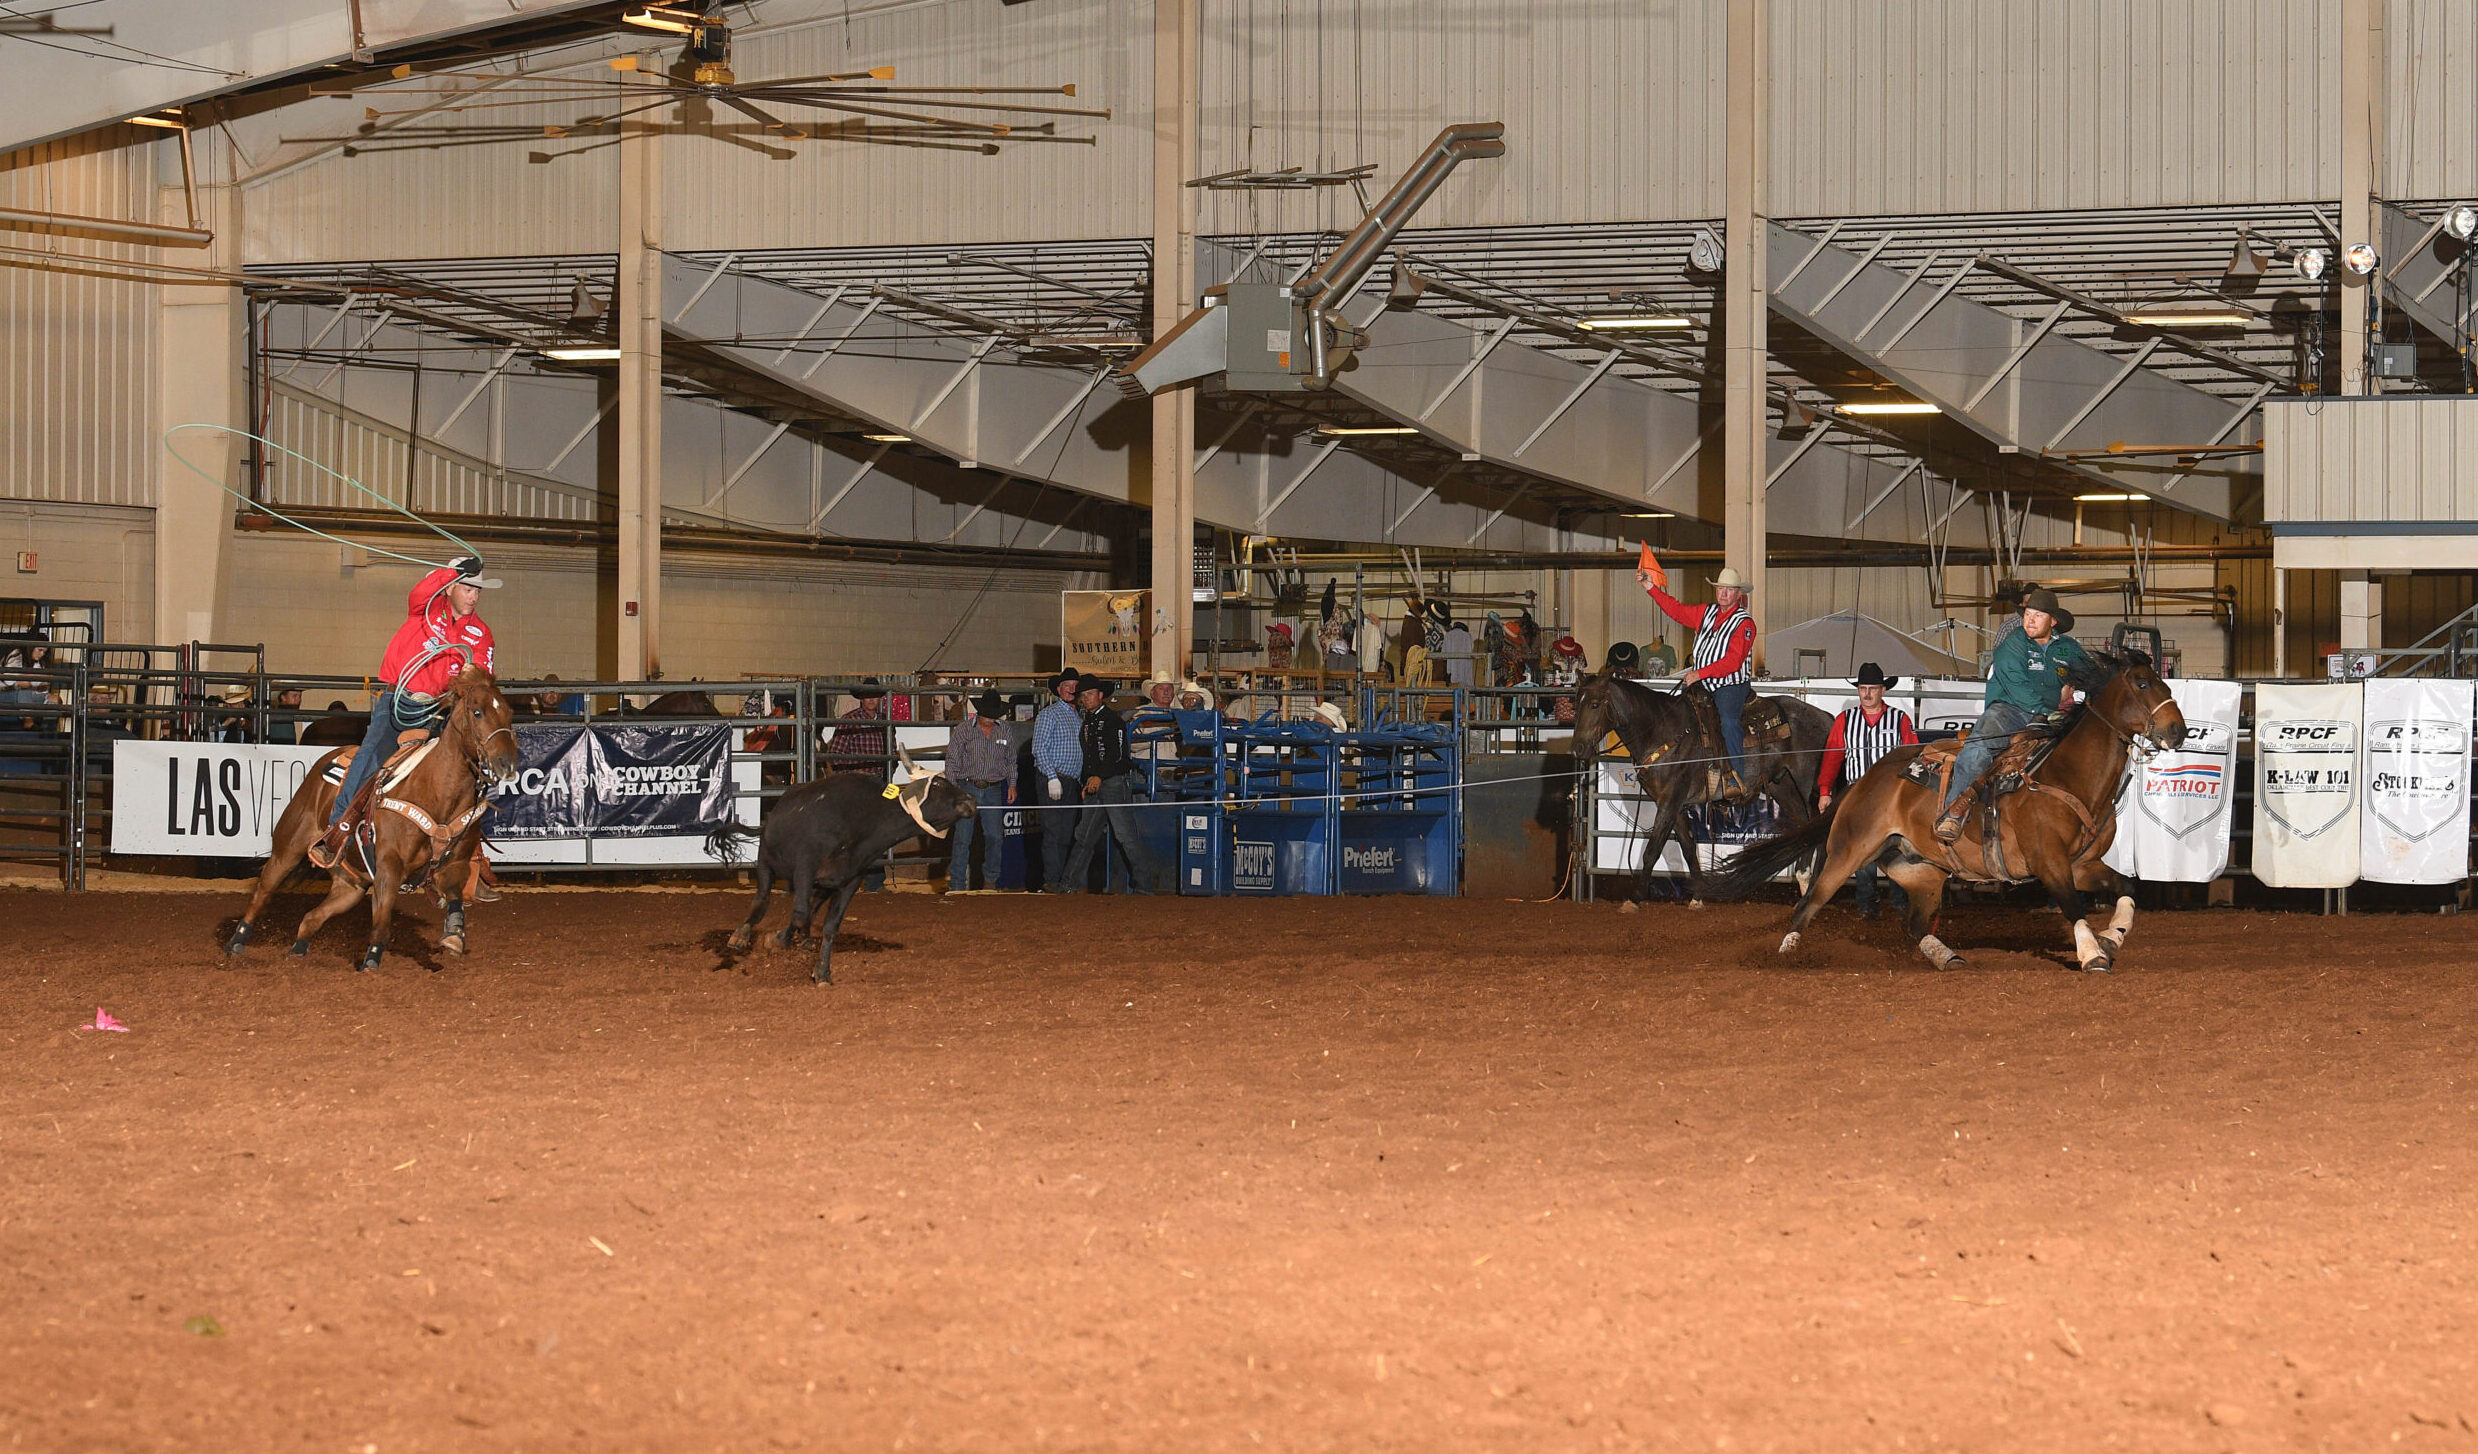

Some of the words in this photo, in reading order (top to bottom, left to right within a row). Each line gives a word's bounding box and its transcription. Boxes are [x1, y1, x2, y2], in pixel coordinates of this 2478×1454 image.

[25, 552, 38, 569] EXIT
[1072, 641, 1136, 653] SOUTHERN
[2278, 726, 2339, 739] RPCF
[613, 764, 701, 782] COWBOY
[2326, 770, 2350, 785] 101
[498, 768, 570, 796] RCA
[613, 781, 702, 797] CHANNEL
[2146, 778, 2221, 795] PATRIOT
[168, 757, 241, 837] LAS
[383, 798, 407, 812] TRENT
[407, 807, 433, 830] WARD
[1343, 846, 1394, 868] Priefert
